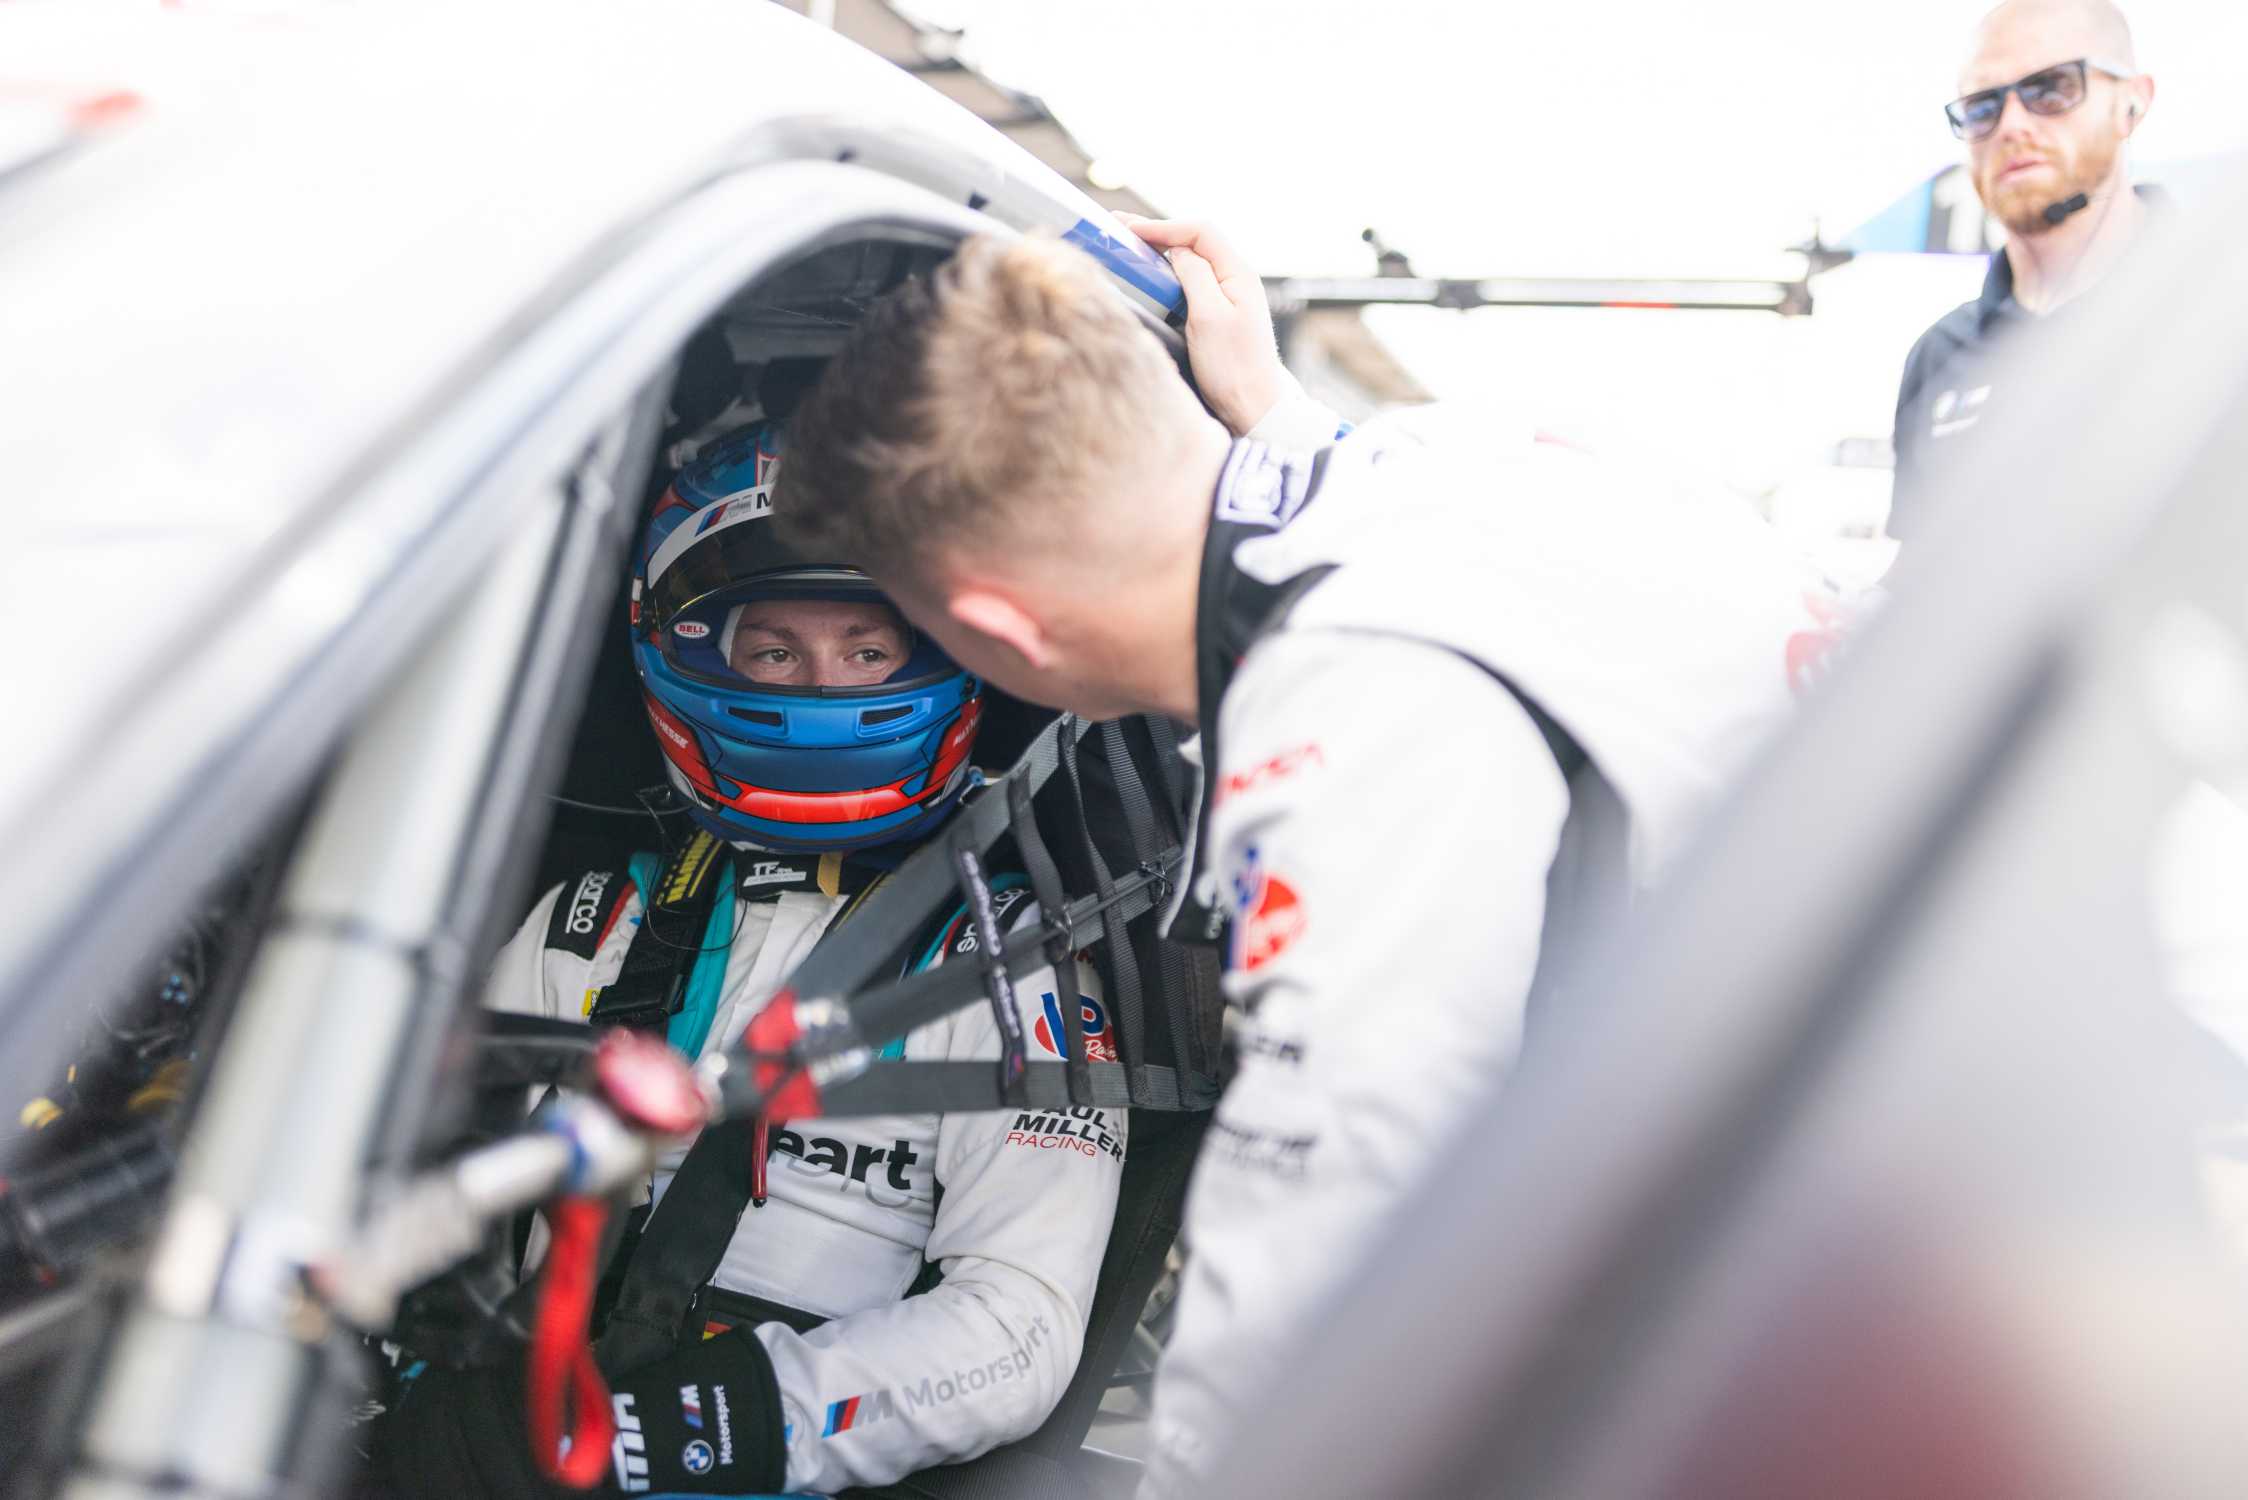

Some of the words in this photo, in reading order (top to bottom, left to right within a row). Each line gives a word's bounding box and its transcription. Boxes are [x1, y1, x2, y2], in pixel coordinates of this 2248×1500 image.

[679, 624, 705, 634] BELL
[1023, 1107, 1107, 1130] AUL
[1005, 1132, 1098, 1158] RACING
[1013, 1113, 1123, 1162] MILLER
[774, 1130, 918, 1190] eart
[713, 1384, 734, 1465] Motorsport
